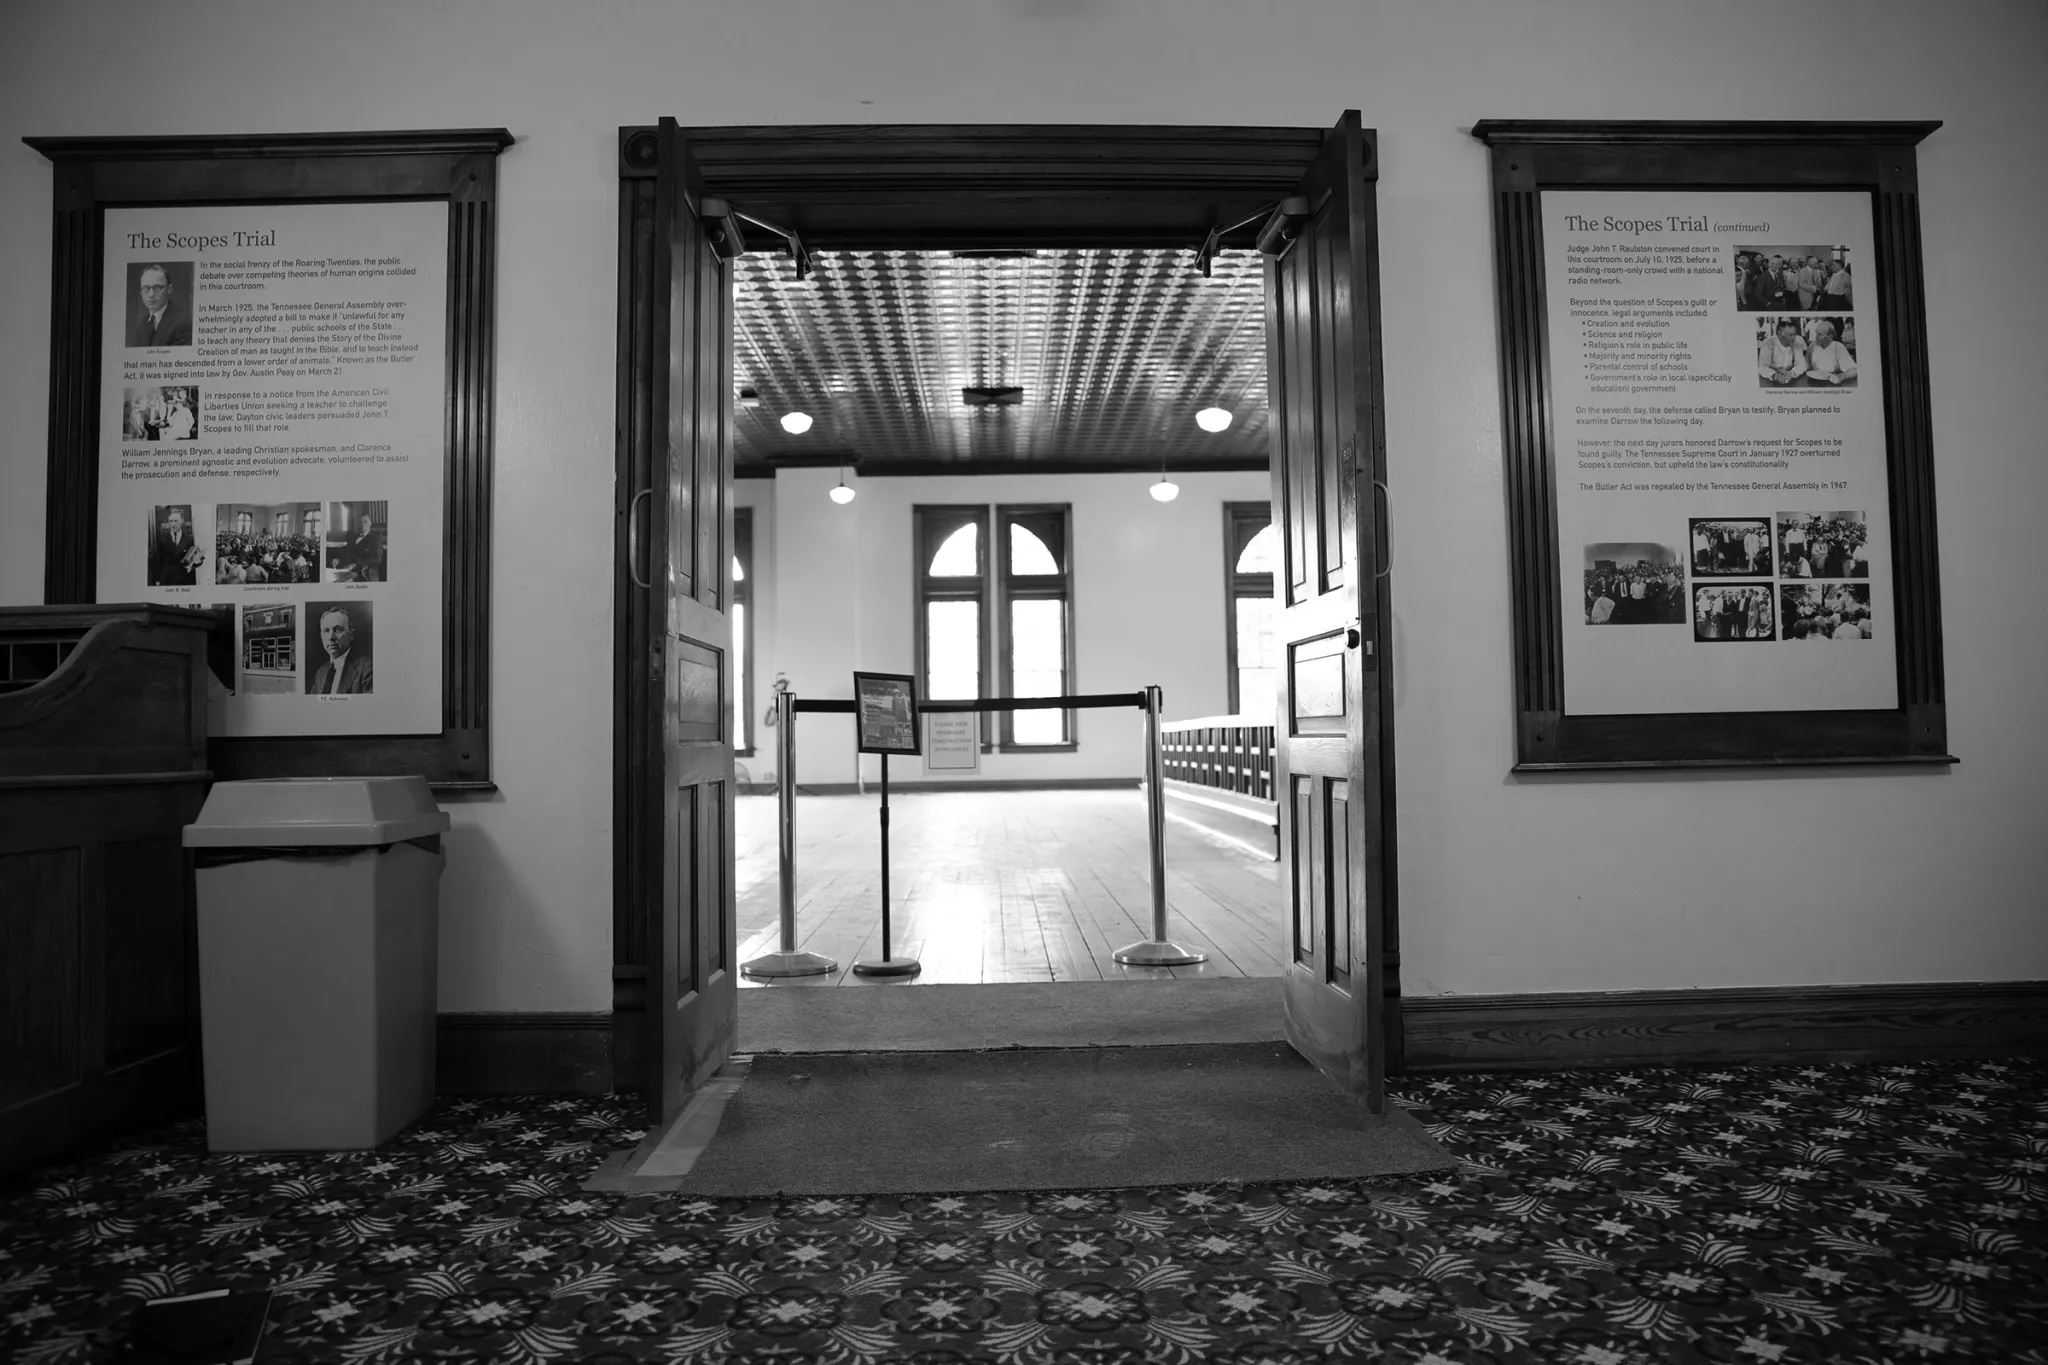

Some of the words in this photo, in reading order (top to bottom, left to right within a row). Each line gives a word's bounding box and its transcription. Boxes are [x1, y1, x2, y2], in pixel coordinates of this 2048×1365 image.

[1564, 215, 1598, 230] The
[1603, 216, 1662, 234] Scopes
[1666, 216, 1708, 231] Trial
[1713, 222, 1770, 232] (continued)
[127, 232, 161, 248] The
[166, 232, 227, 251] Scopes
[232, 230, 275, 246] Trial
[1566, 245, 1589, 253] Judge
[247, 260, 271, 268] frenzy
[295, 258, 325, 268] Roaring
[377, 257, 400, 265] public
[1635, 256, 1651, 264] July
[245, 272, 285, 280] competing
[1569, 298, 1598, 306] Beyond
[1690, 299, 1707, 307] guilt
[245, 336, 271, 344] theory
[331, 334, 352, 343] Story
[1634, 331, 1662, 339] religion
[1588, 341, 1624, 349] Religion’s
[1588, 352, 1619, 360] Majority
[1669, 352, 1692, 361] rights
[266, 402, 297, 410] seeking
[348, 400, 387, 408] challenge
[1685, 483, 1695, 491] by
